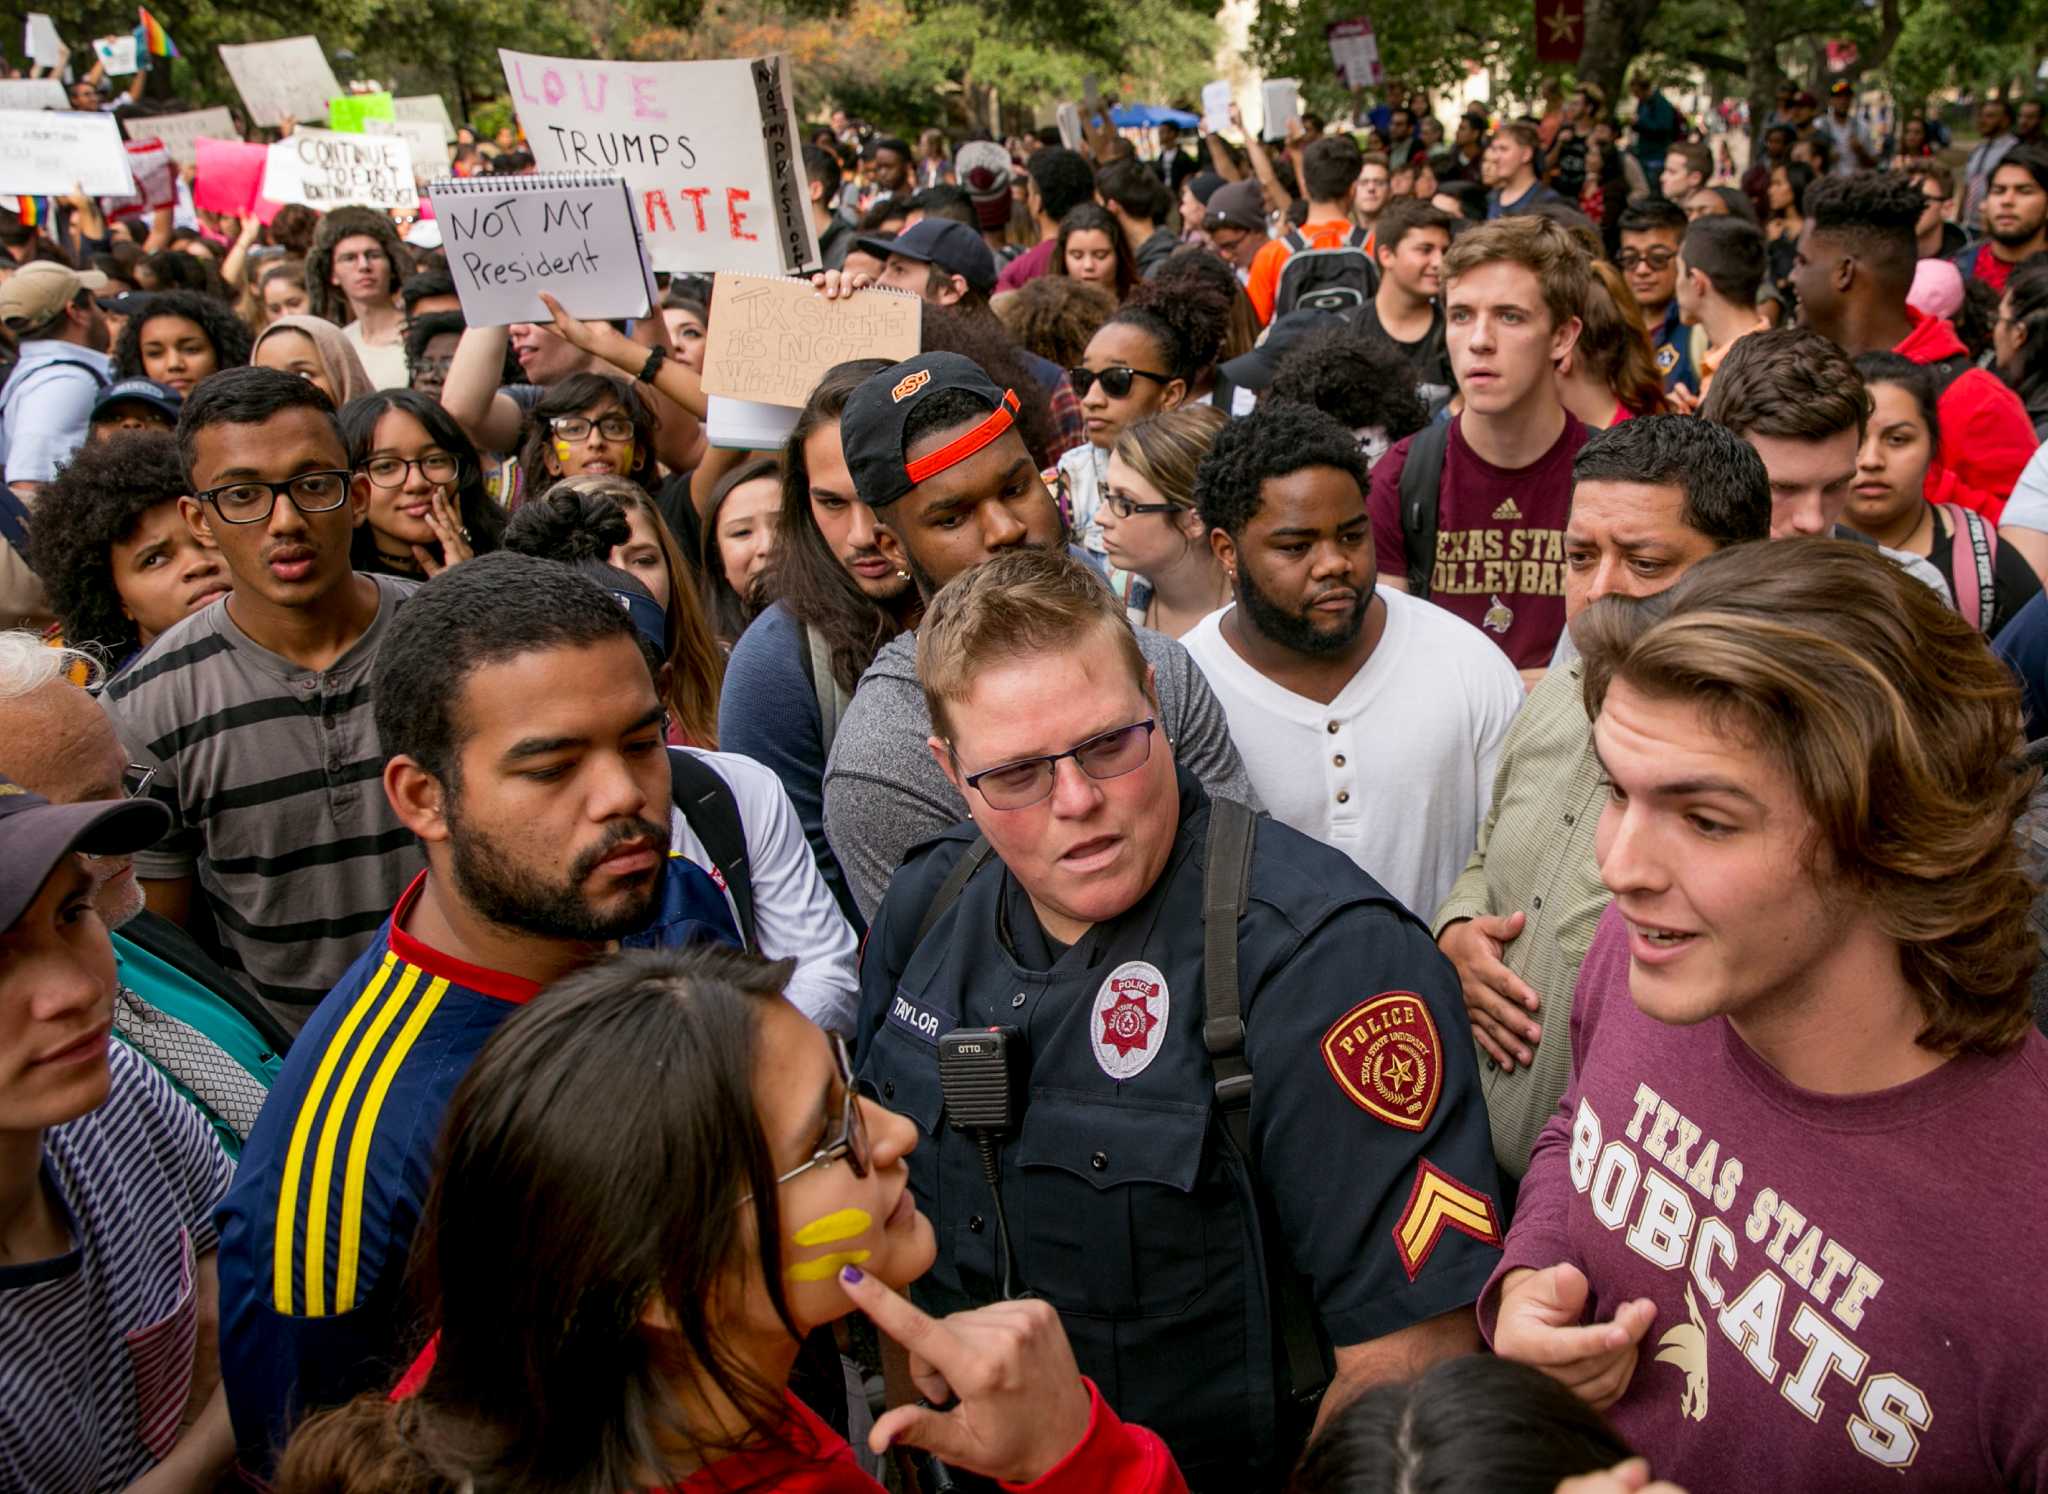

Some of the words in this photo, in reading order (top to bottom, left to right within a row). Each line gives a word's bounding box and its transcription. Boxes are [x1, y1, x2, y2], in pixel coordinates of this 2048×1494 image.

[514, 61, 669, 121] LOVE
[298, 137, 397, 168] CONTINUE
[548, 124, 697, 169] TRUMPS
[450, 198, 522, 241] NOT
[543, 199, 594, 233] MY
[643, 186, 759, 241] ATE
[462, 239, 600, 291] President
[778, 332, 874, 364] NOT
[1435, 529, 1504, 561] EXAS
[1118, 979, 1153, 994] POLICE
[893, 996, 939, 1037] TAYLOR
[1339, 1006, 1416, 1056] POLICE
[958, 1043, 981, 1054] OTTO
[1361, 1055, 1373, 1086] TEXAS
[1368, 1034, 1390, 1057] STATE
[1625, 1082, 1744, 1212] TEXAS
[1745, 1187, 1884, 1332] STATE
[1569, 1096, 1934, 1469] BOBCATS
